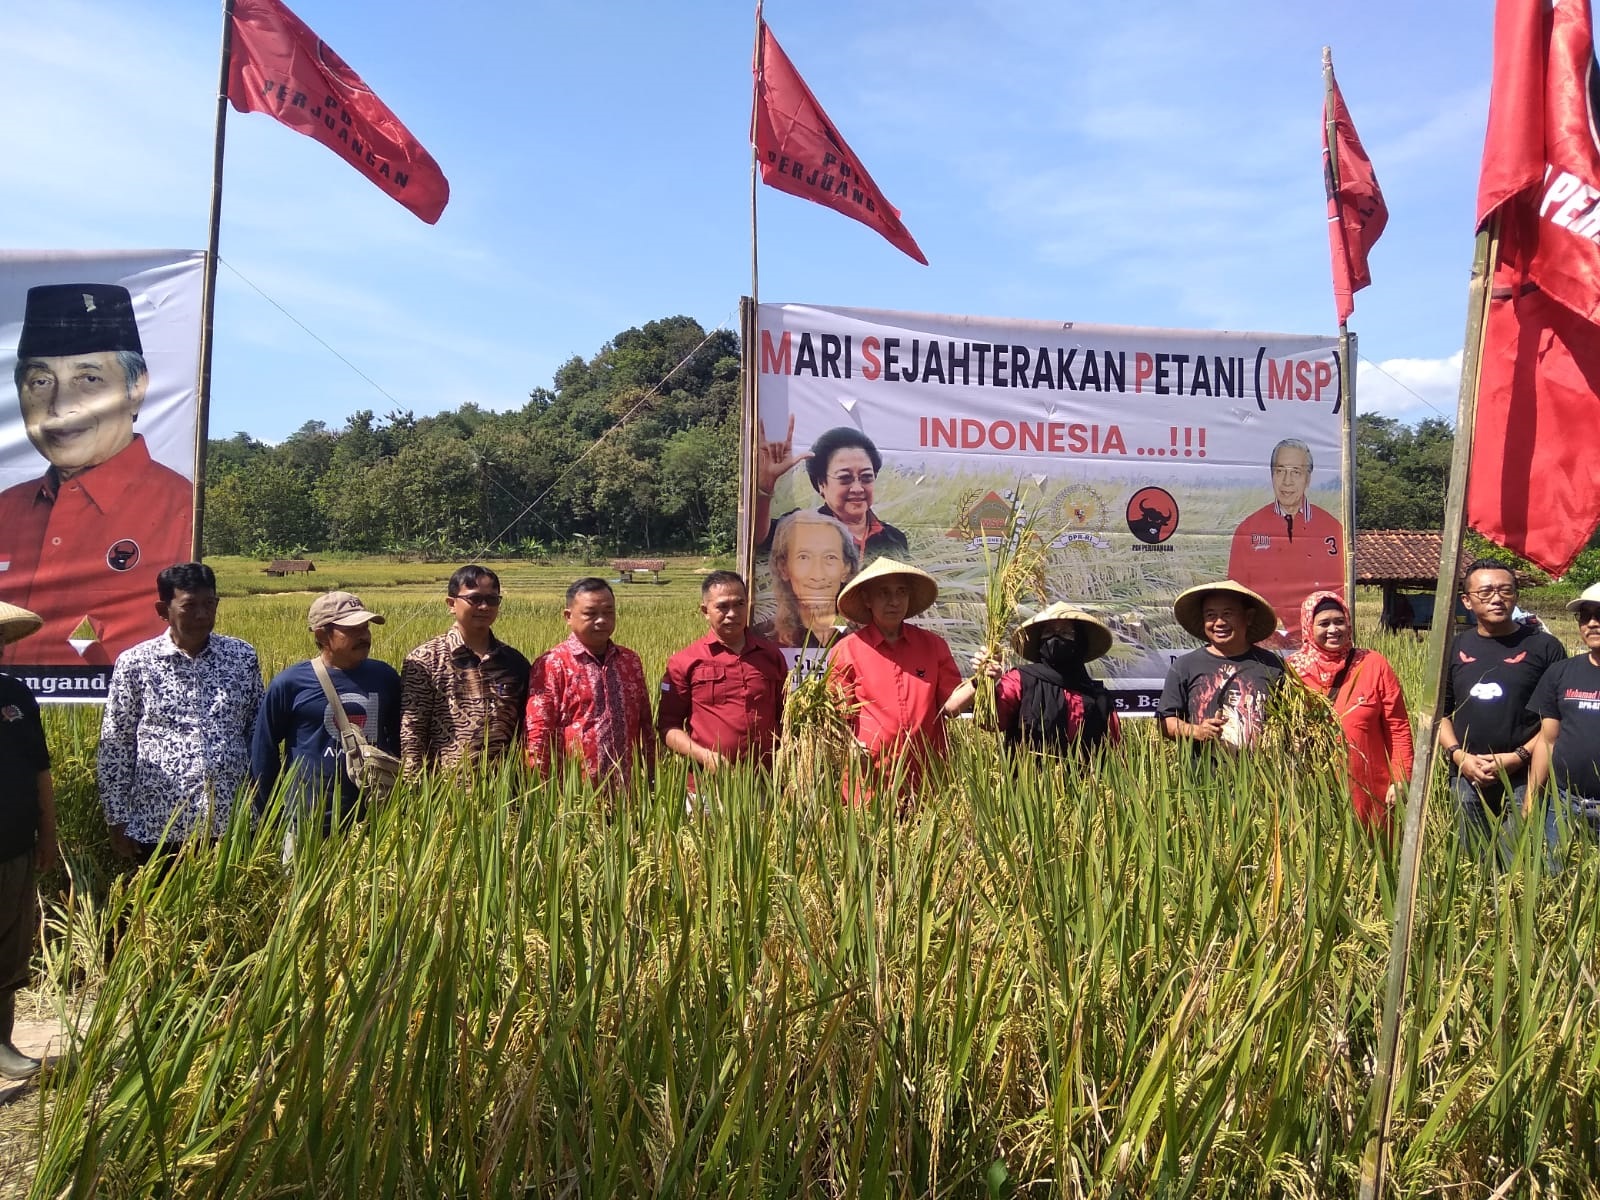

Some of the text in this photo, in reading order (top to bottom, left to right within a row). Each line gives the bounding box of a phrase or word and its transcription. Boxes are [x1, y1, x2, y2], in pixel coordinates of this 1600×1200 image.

[262, 79, 408, 189] PERJUANGAN
[767, 150, 885, 222] PERJUANG
[761, 329, 1341, 415] MARI SEJAHTERAKAN PETANI (MSP)
[919, 416, 1127, 455] INDONESIA
[981, 518, 1005, 528] MSP
[1324, 537, 1338, 555] 3
[16, 673, 111, 693] ngand
[1137, 695, 1160, 708] Ba
